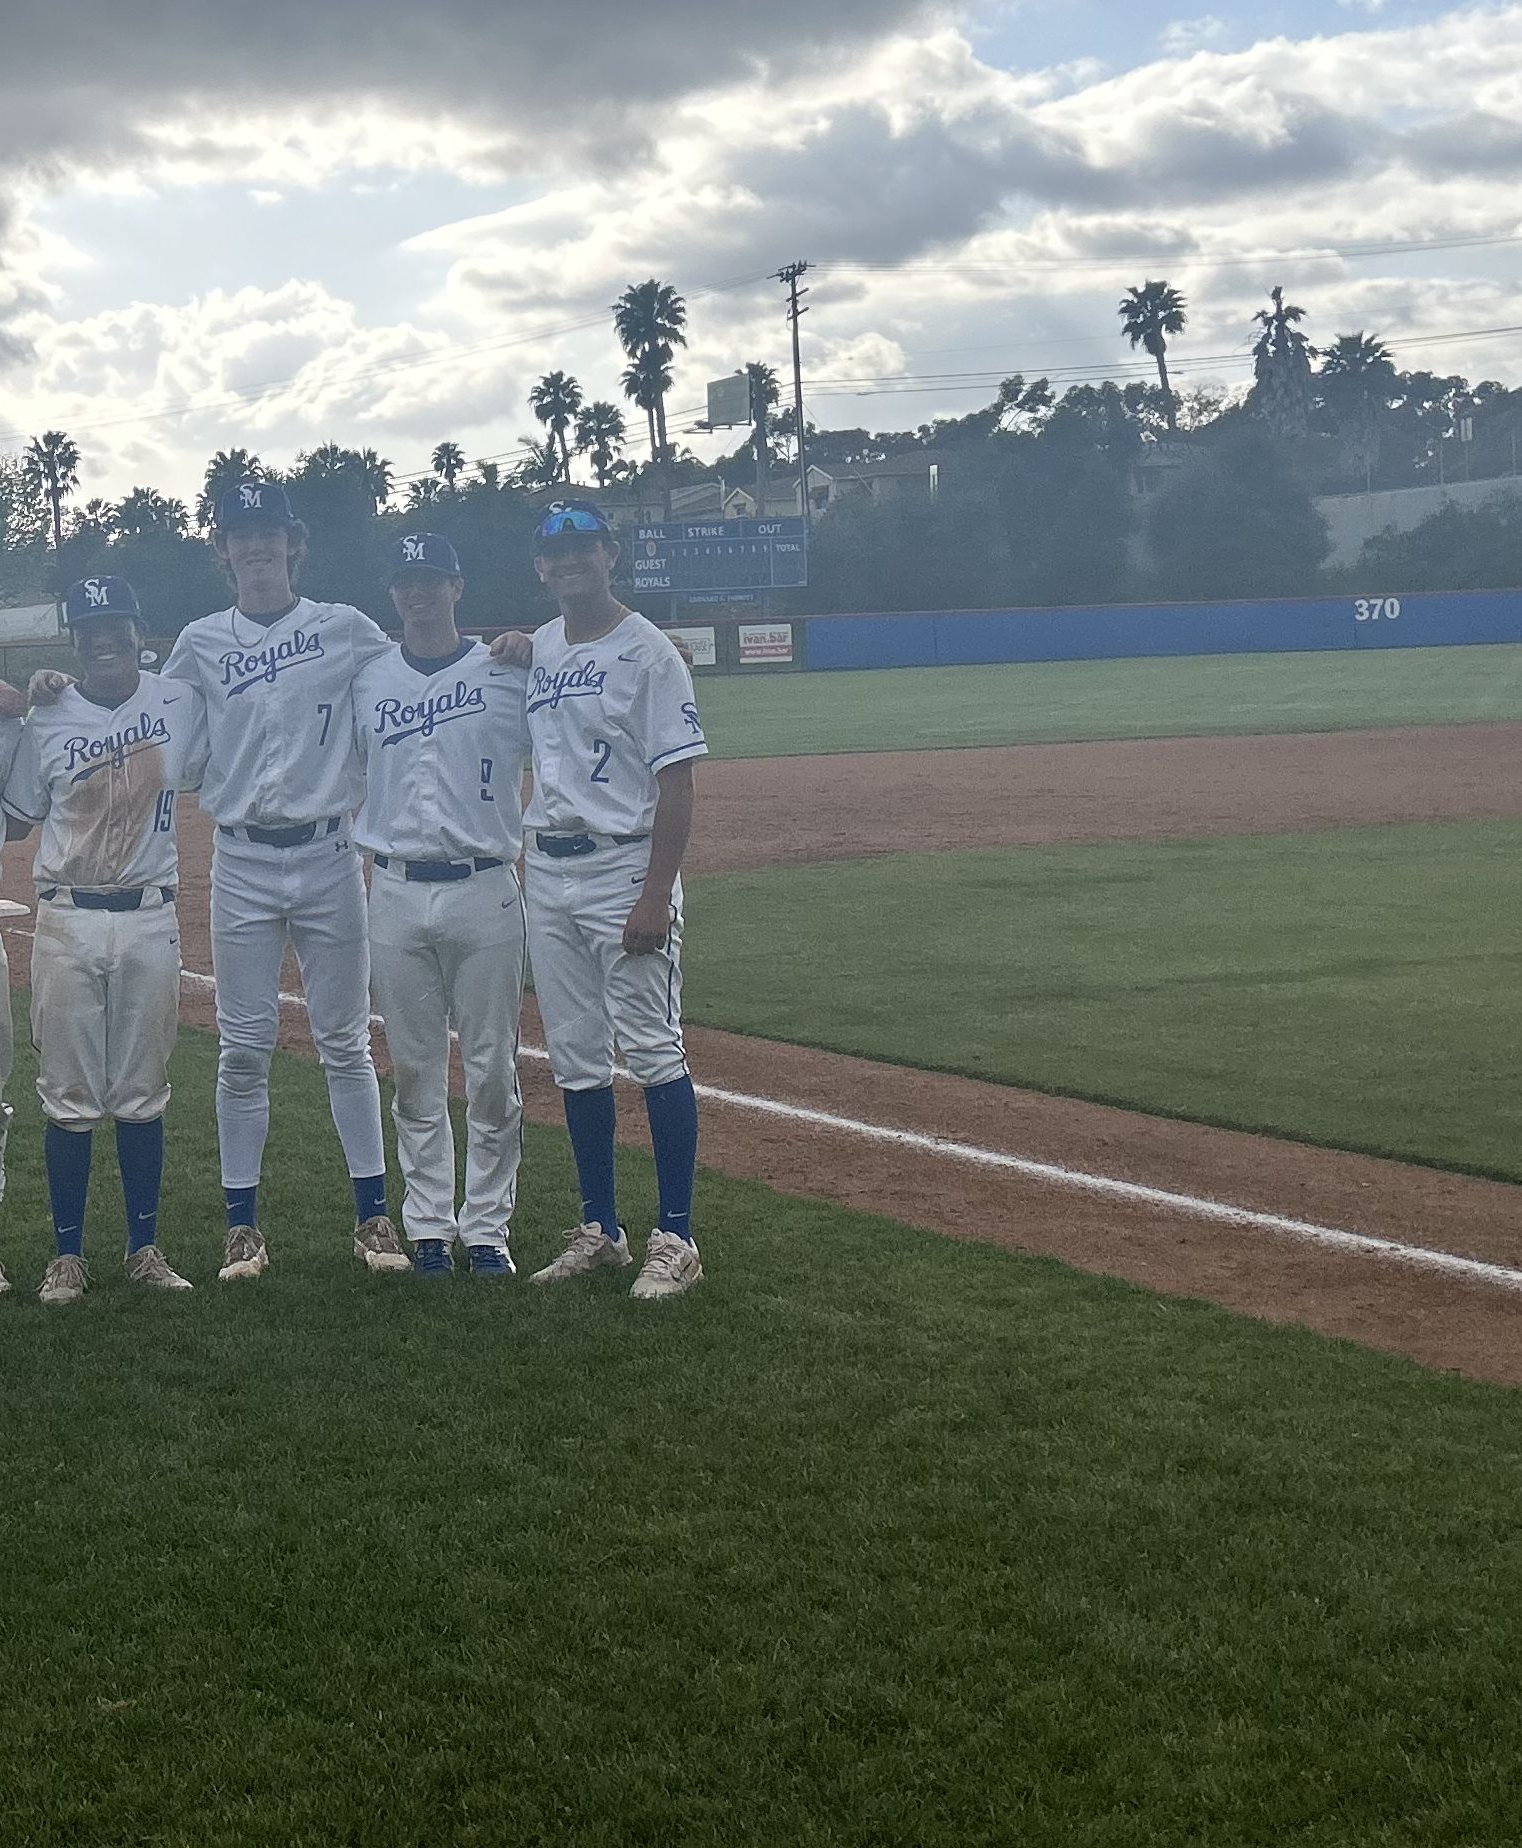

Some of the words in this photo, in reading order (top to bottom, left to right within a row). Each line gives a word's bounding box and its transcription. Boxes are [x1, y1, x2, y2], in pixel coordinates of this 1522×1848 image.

[239, 484, 262, 509] SM
[638, 529, 666, 539] BALL
[687, 526, 725, 537] STRIKE
[758, 524, 782, 534] OUT
[402, 536, 425, 561] SM
[776, 543, 800, 552] TOTAL
[635, 558, 666, 570] GUEST
[84, 579, 110, 607] SM
[635, 577, 671, 589] ROYALS
[1354, 597, 1400, 621] 370
[219, 630, 325, 700] Royals
[528, 660, 607, 713] Royals
[317, 704, 332, 746] 7
[374, 681, 486, 749] Royals
[63, 712, 171, 785] Royals
[590, 738, 612, 783] 2
[153, 790, 175, 832] 19
